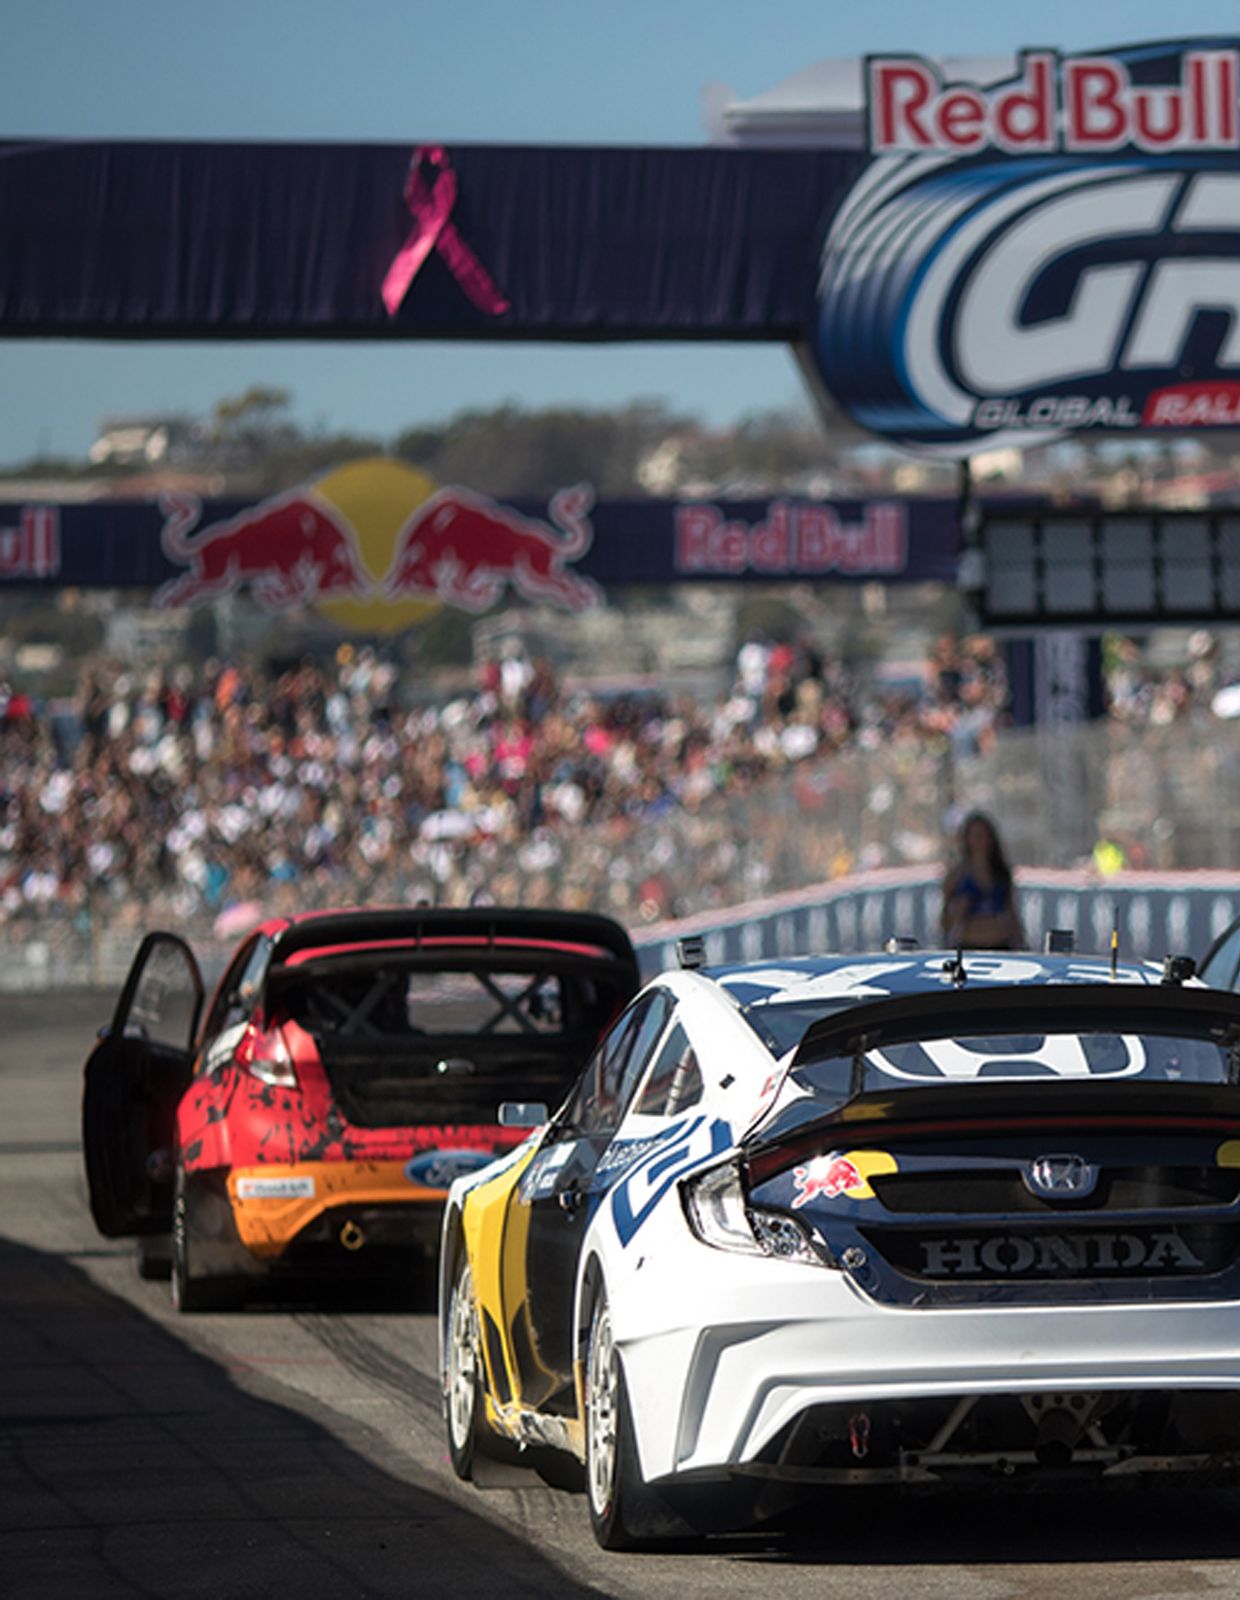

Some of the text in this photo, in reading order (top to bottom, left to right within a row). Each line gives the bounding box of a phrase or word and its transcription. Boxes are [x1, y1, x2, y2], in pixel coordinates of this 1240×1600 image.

[872, 54, 1055, 148] Red
[974, 396, 1142, 430] GLOBAL
[676, 504, 908, 575] Red Bull
[921, 1232, 1204, 1276] HONDA
